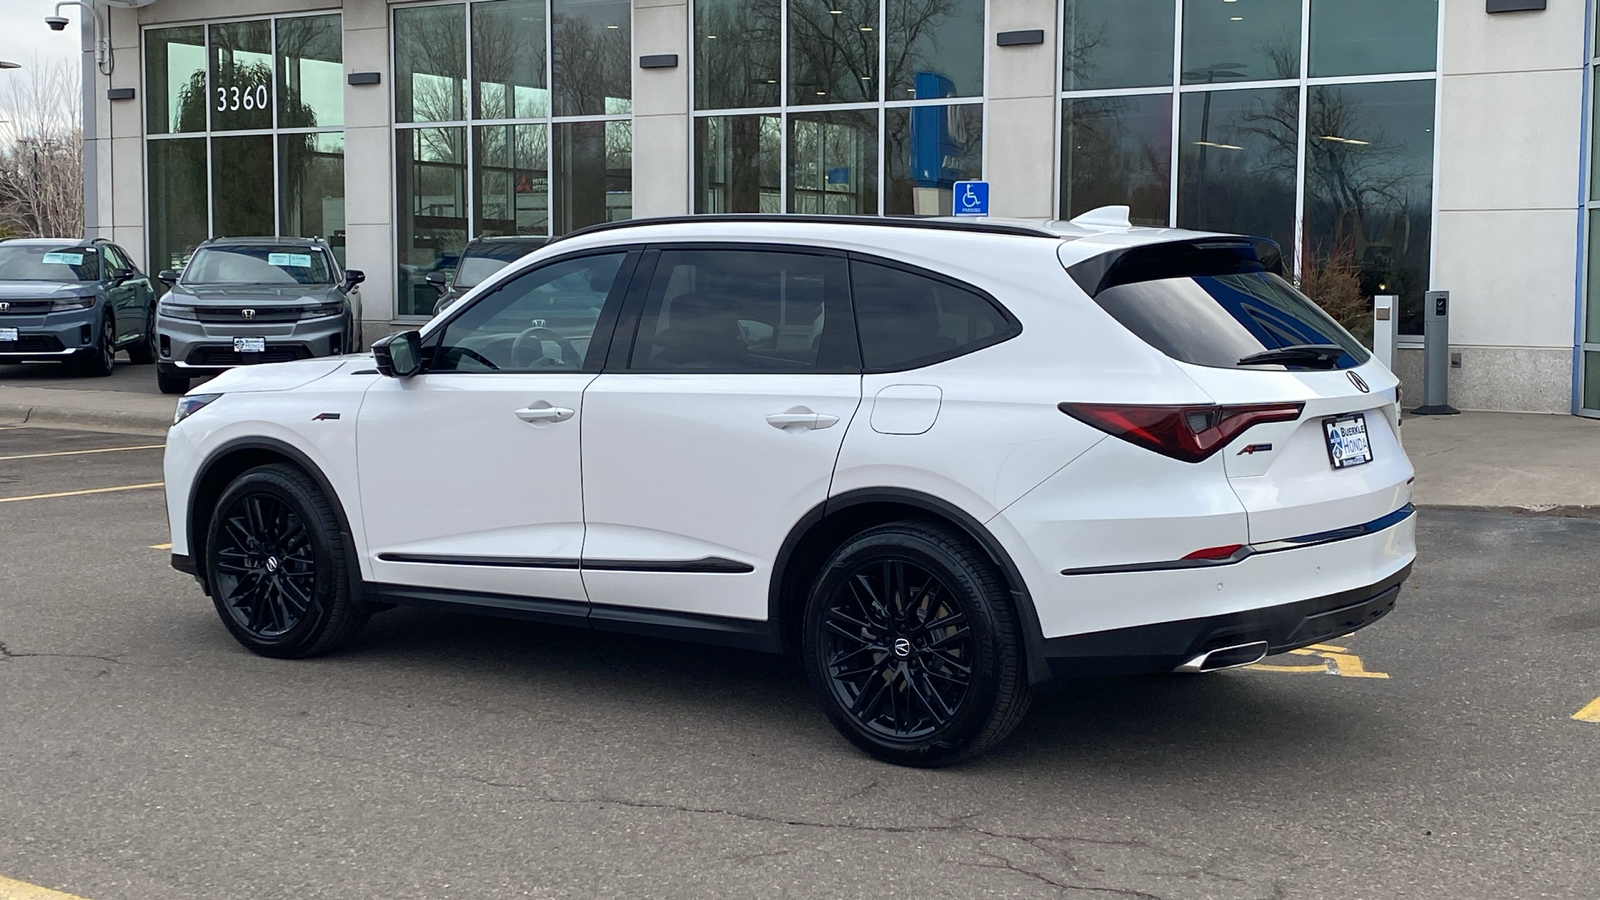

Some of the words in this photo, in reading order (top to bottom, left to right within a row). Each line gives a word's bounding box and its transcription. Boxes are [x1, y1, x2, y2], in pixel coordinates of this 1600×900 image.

[217, 85, 267, 111] 3360
[1340, 425, 1365, 437] BUERKLE
[1342, 438, 1368, 454] HONDA
